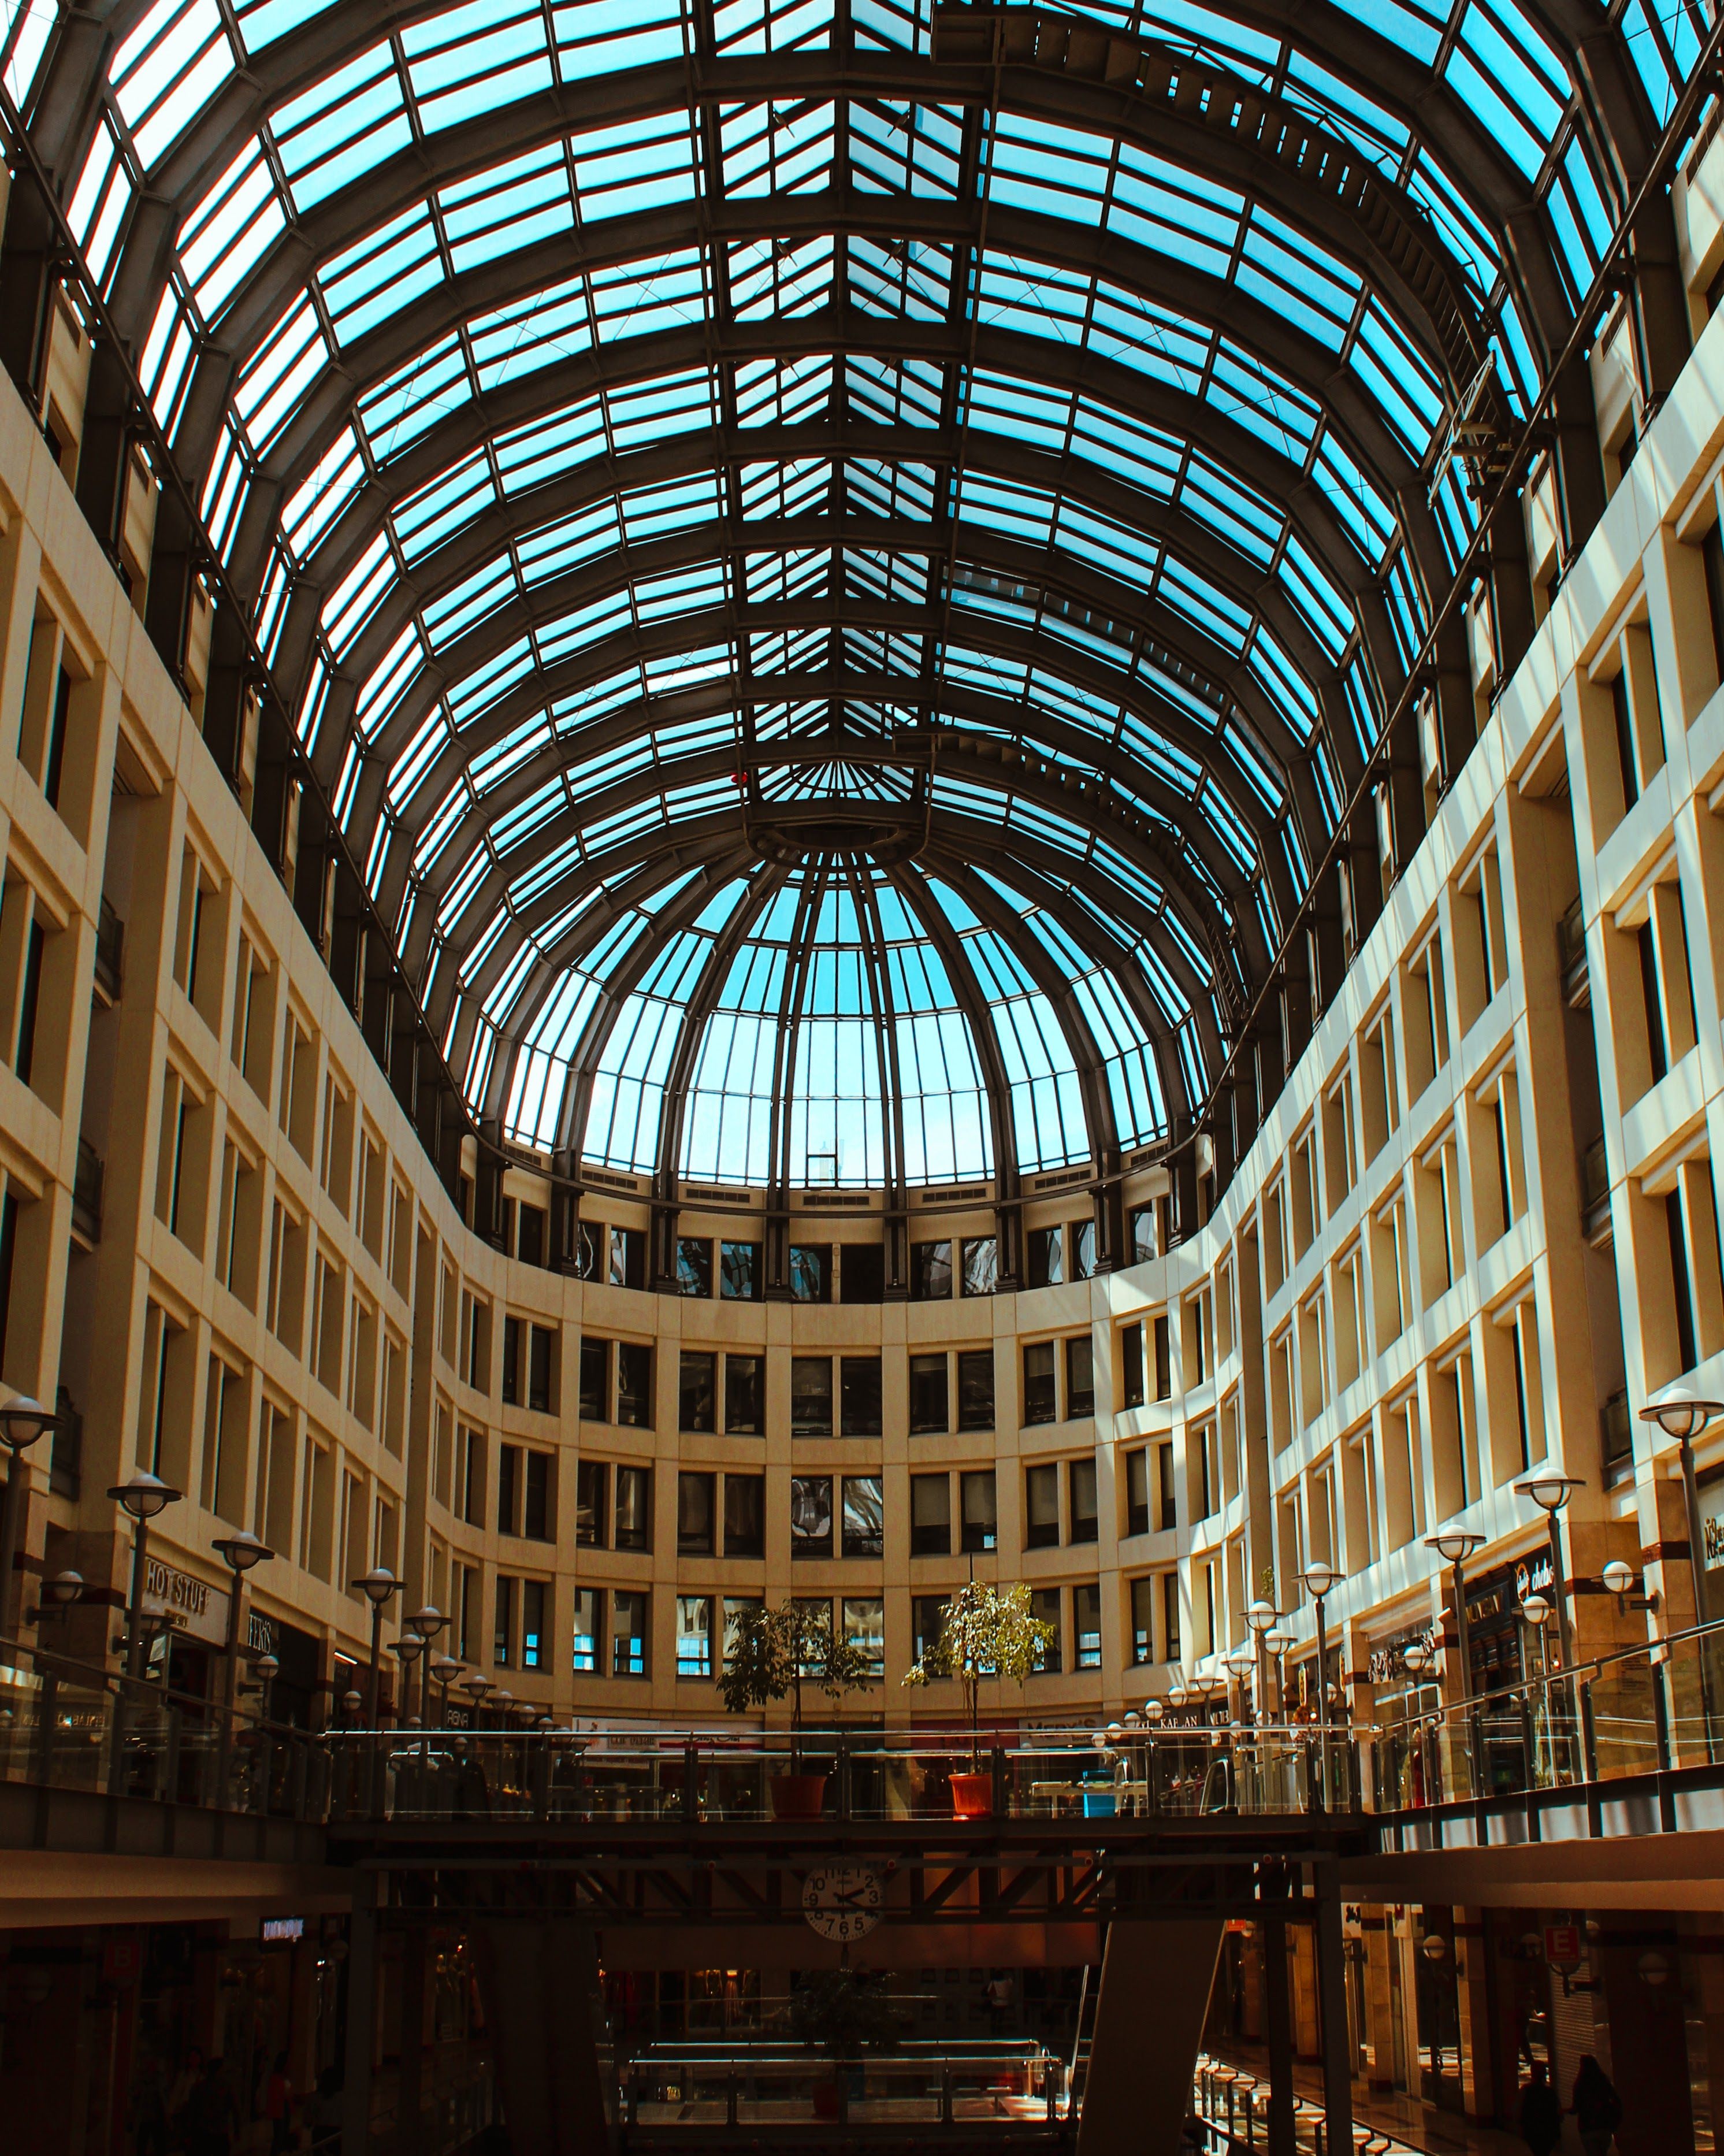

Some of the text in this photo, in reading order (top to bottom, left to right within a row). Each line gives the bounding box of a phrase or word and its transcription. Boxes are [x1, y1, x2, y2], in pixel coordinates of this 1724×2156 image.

[147, 1561, 173, 1600] HOT
[1160, 1716, 1198, 1729] KAPAN
[809, 1877, 825, 1891] 10
[865, 1875, 874, 1888] 2
[809, 1892, 819, 1906] 9
[869, 1890, 879, 1903] 3
[826, 1918, 835, 1931] 7
[839, 1921, 849, 1935] 6
[854, 1917, 864, 1931] 5
[1552, 1929, 1571, 1953] E
